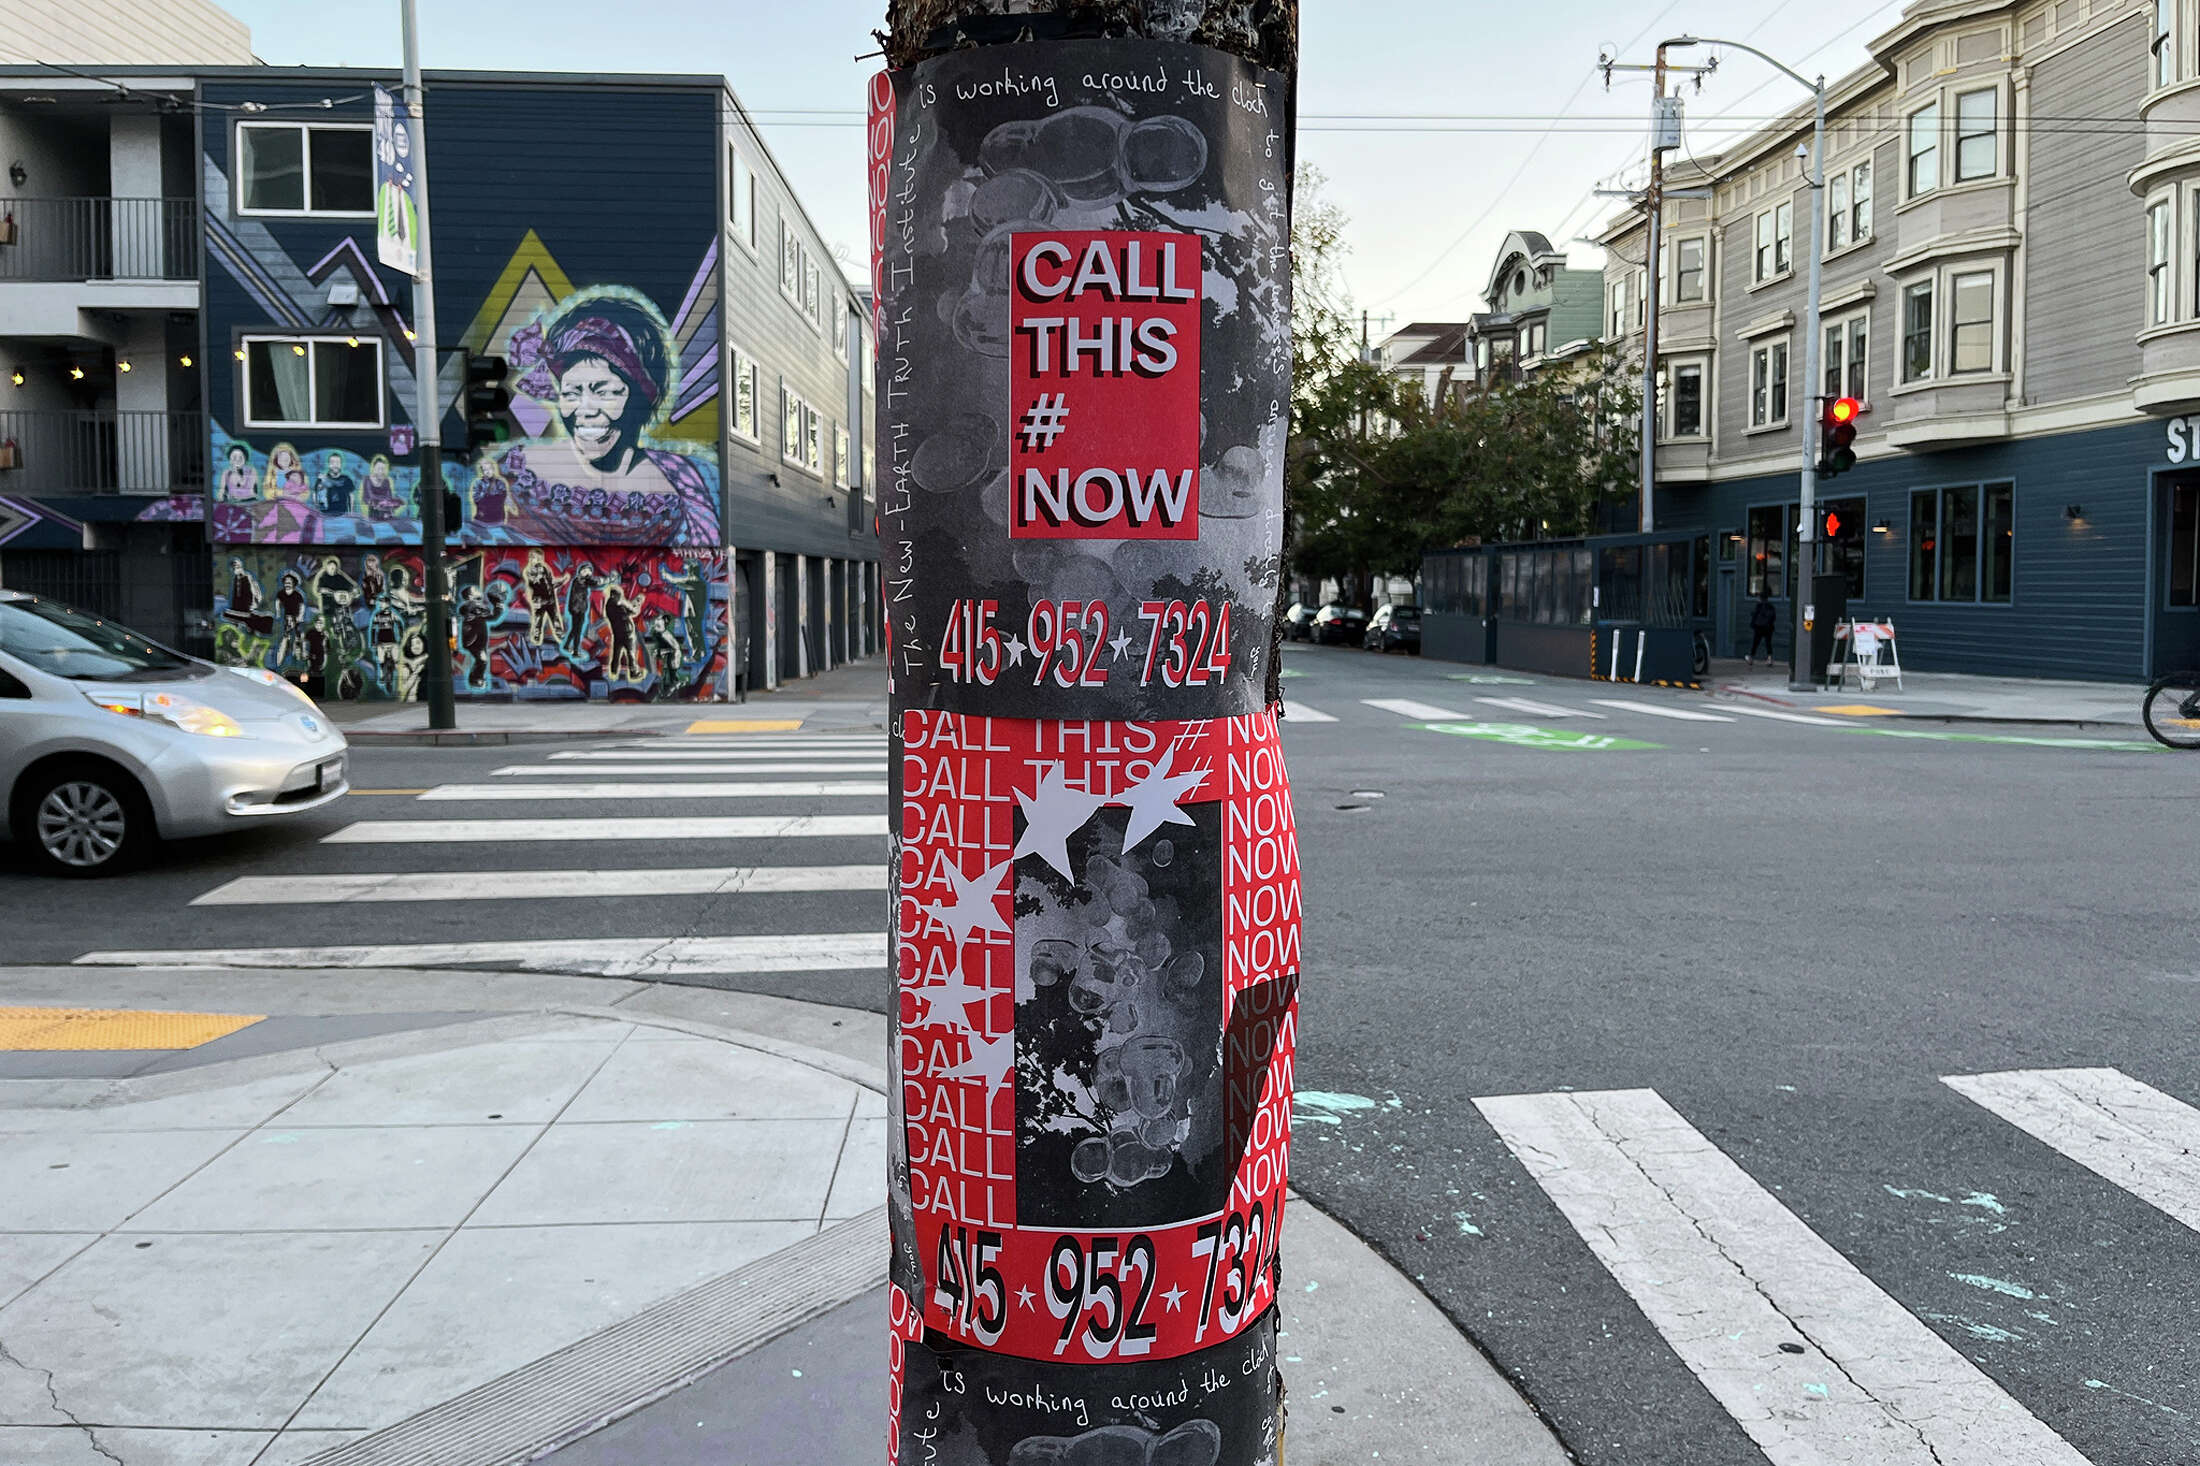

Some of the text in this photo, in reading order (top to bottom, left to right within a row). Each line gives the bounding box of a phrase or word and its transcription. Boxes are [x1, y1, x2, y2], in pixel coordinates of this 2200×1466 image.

[918, 84, 937, 110] is
[956, 67, 1057, 107] working
[1083, 68, 1168, 92] around
[1183, 70, 1221, 99] the
[1264, 128, 1280, 158] to
[890, 122, 921, 289] Institute
[1017, 240, 1196, 303] CALL
[1268, 246, 1285, 274] the
[1016, 316, 1179, 378] THIS
[1016, 393, 1070, 453] #
[1018, 467, 1194, 528] NOW
[904, 616, 924, 676] The
[939, 599, 1232, 688] 415 952 7324
[903, 709, 1011, 752] CALL
[1035, 719, 1157, 754] THIS
[903, 754, 1011, 802] CALL
[1227, 744, 1290, 796] NOW
[902, 801, 1011, 850] CALL
[1228, 788, 1296, 843] NOW
[1228, 831, 1301, 887] NOW
[1228, 878, 1303, 936] NOW
[1228, 923, 1301, 982] NOW
[900, 986, 1012, 1039] CL
[903, 1079, 1013, 1136] CALL
[906, 1121, 1013, 1181] CALL
[910, 1167, 1014, 1230] CALL
[933, 1223, 1008, 1347] 415
[1043, 1234, 1157, 1359] 952
[985, 1383, 1090, 1427] working
[1111, 1378, 1189, 1410] around
[1199, 1368, 1231, 1394] the
